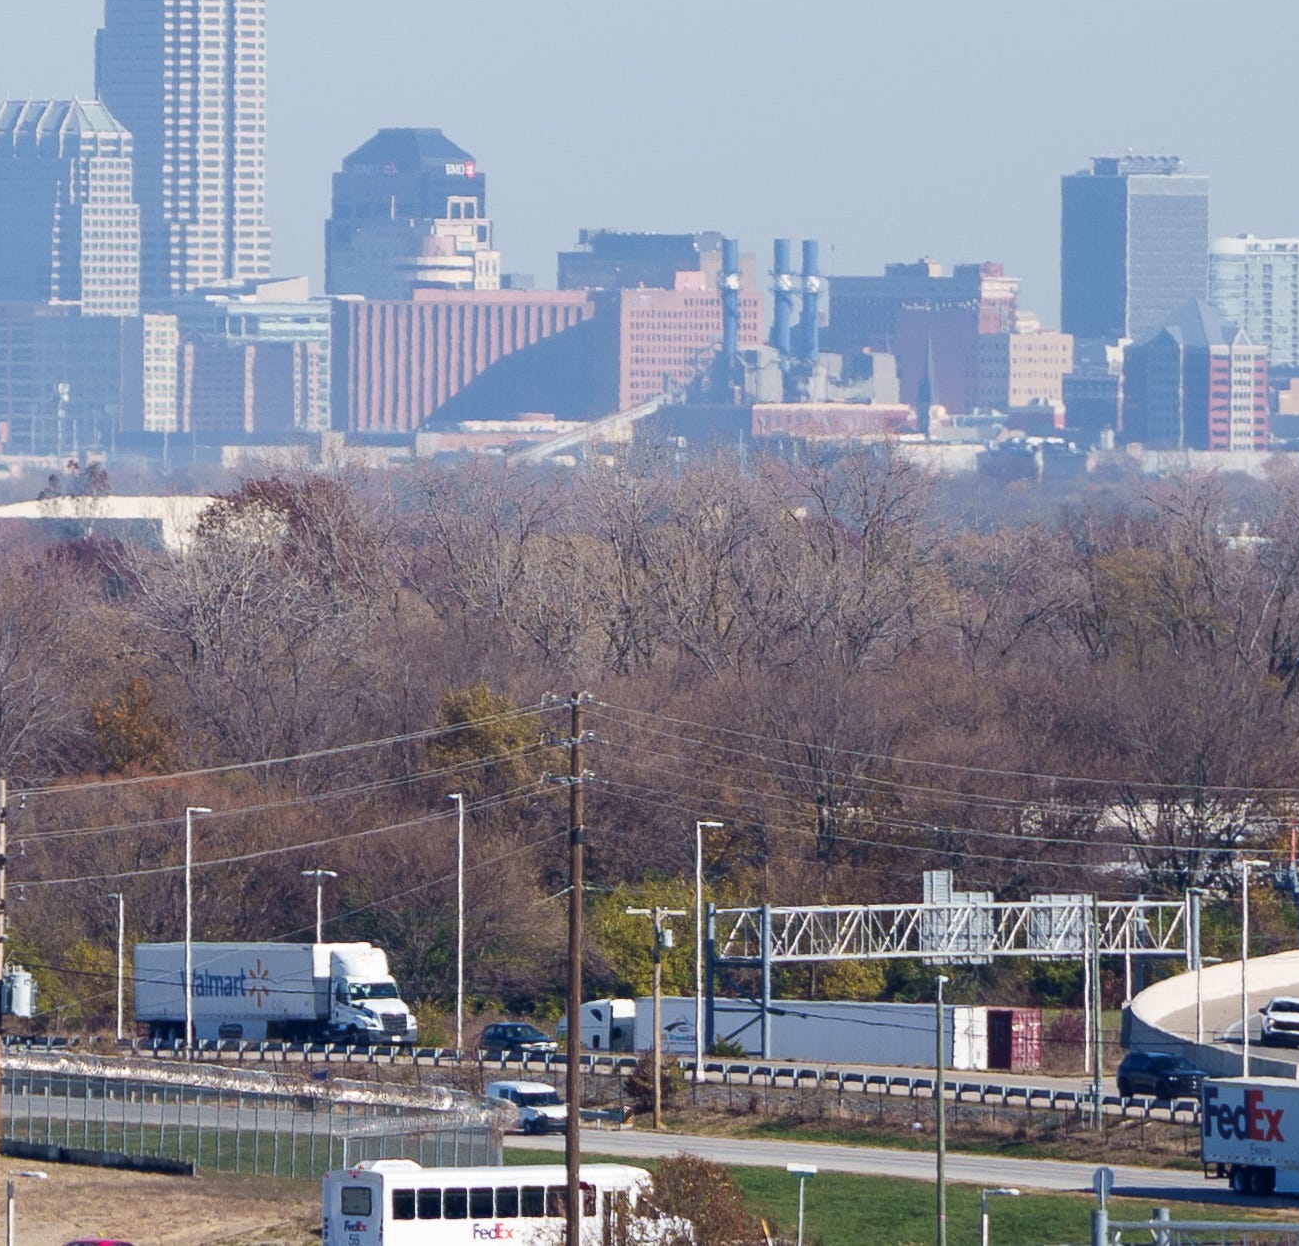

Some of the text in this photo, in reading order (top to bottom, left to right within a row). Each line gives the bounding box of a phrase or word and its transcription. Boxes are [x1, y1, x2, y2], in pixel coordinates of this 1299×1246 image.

[1203, 1085, 1286, 1143] FedEx
[343, 1220, 368, 1232] FedEx
[472, 1223, 514, 1240] FedEx
